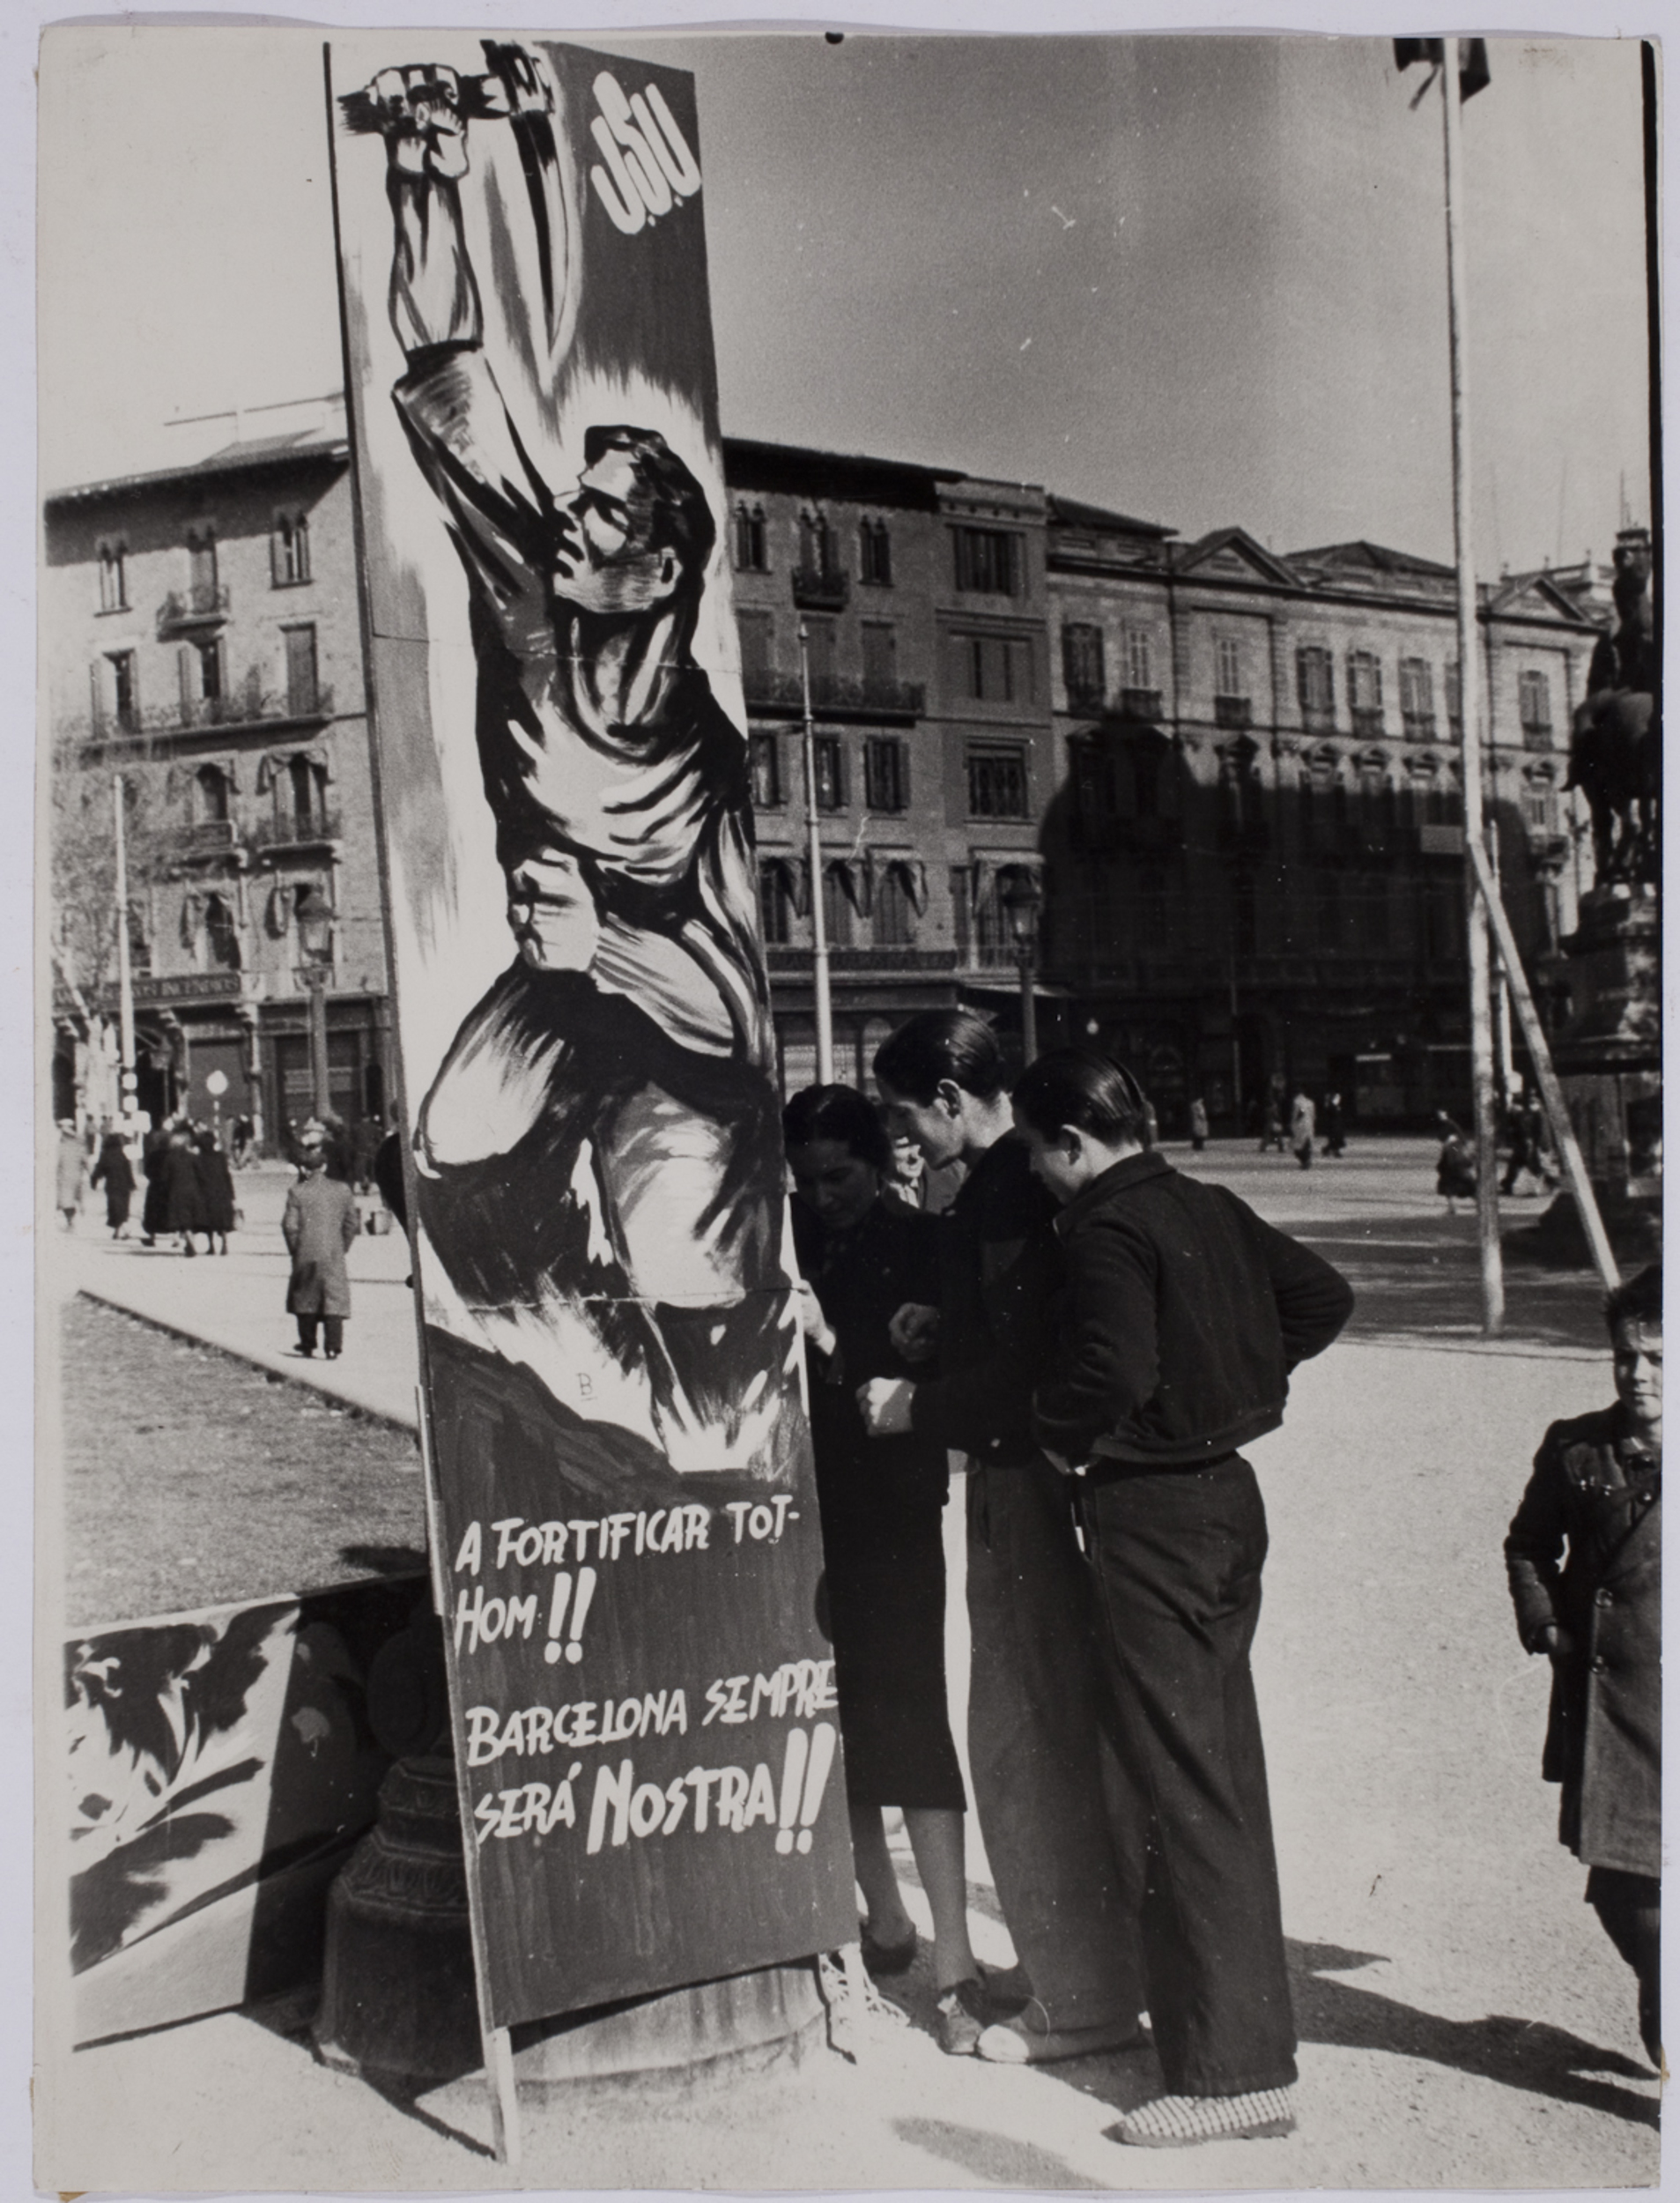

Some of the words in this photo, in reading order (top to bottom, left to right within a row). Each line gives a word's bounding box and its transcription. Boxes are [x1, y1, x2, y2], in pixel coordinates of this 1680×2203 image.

[455, 1520, 482, 1576] A
[492, 1503, 710, 1570] FORTIFICAR
[465, 1688, 688, 1767] BARCELONA
[702, 1659, 839, 1725] SEMPRE
[475, 1762, 582, 1846] SERÁ
